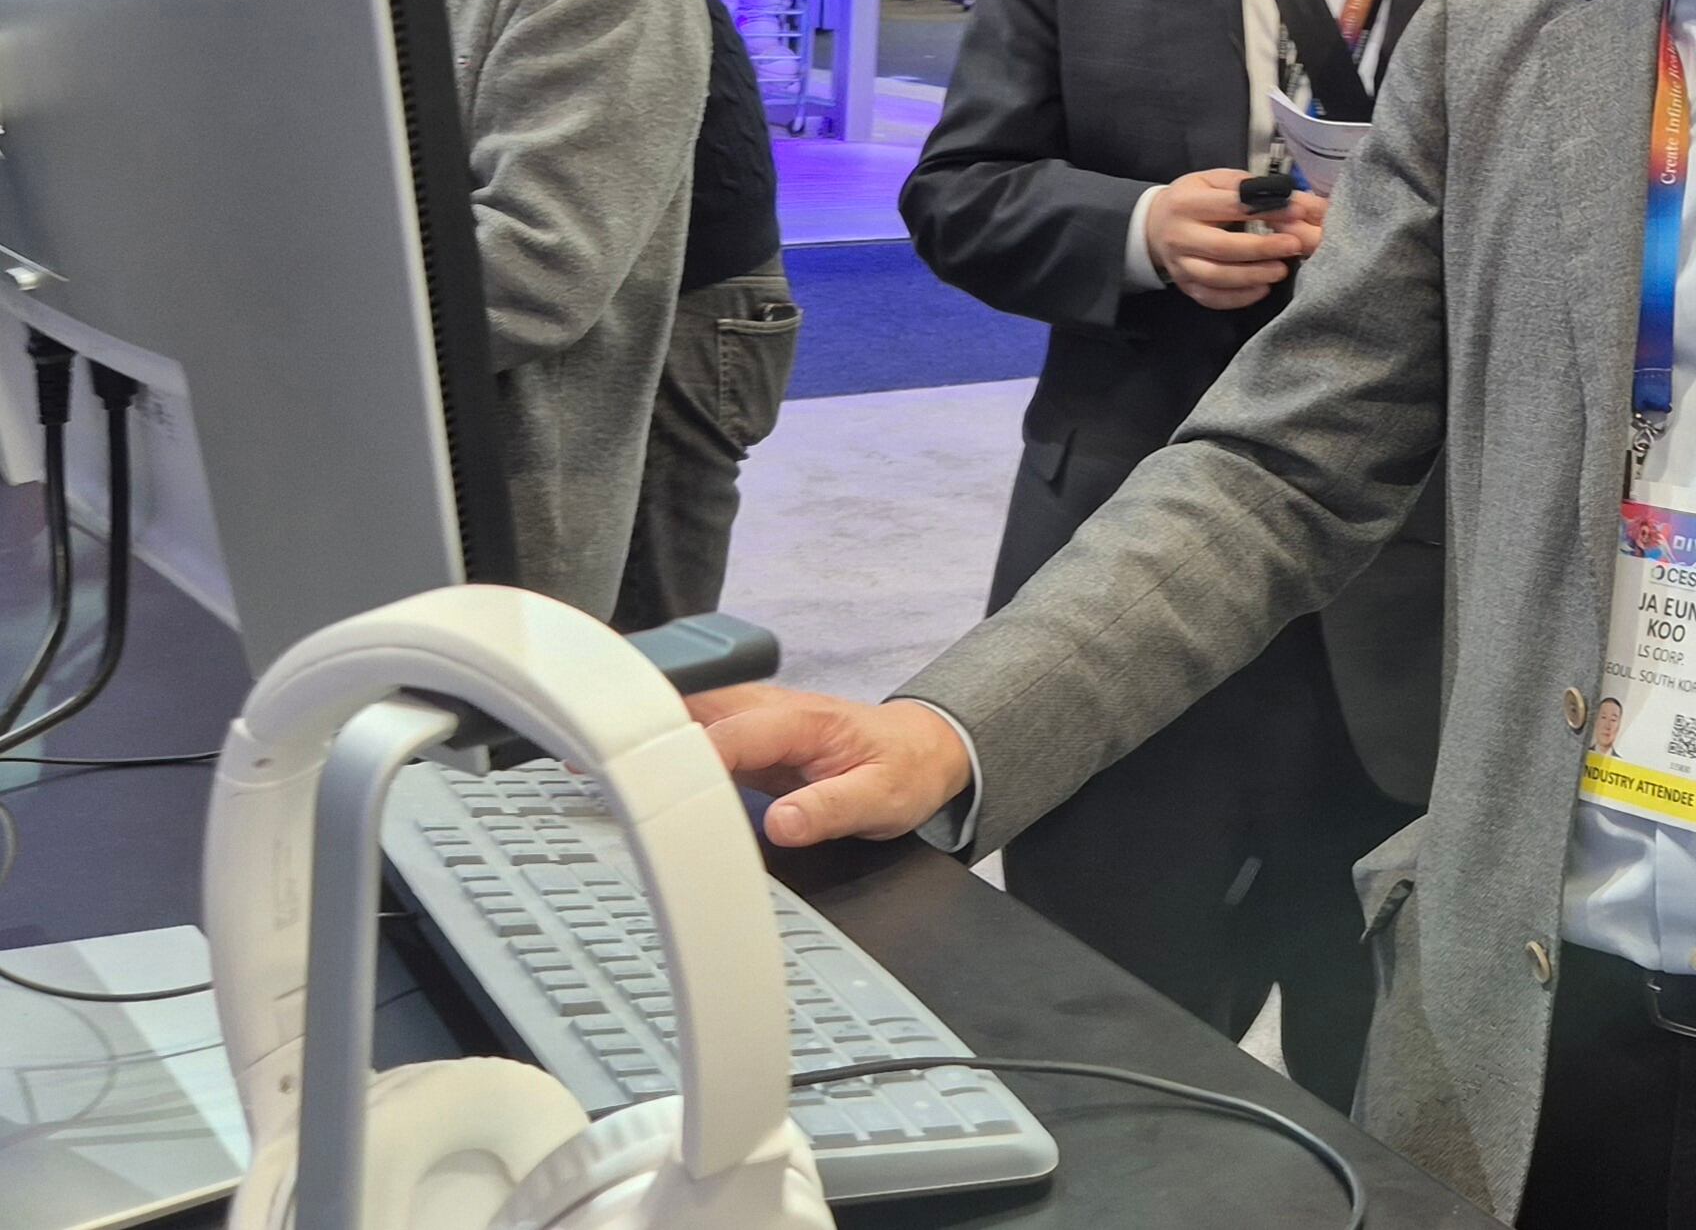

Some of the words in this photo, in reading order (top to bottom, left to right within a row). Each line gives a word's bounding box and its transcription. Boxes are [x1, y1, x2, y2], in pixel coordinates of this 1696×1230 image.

[1665, 83, 1683, 134] Infinite
[1660, 138, 1681, 185] Create
[1637, 591, 1658, 615] JA
[1646, 617, 1686, 643] KOO
[1637, 643, 1651, 659] LS
[1652, 646, 1685, 666] CORP.
[1638, 669, 1676, 690] SOUTH
[1583, 764, 1636, 791] NDUSTRY
[1635, 779, 1696, 808] ATTENDEE
